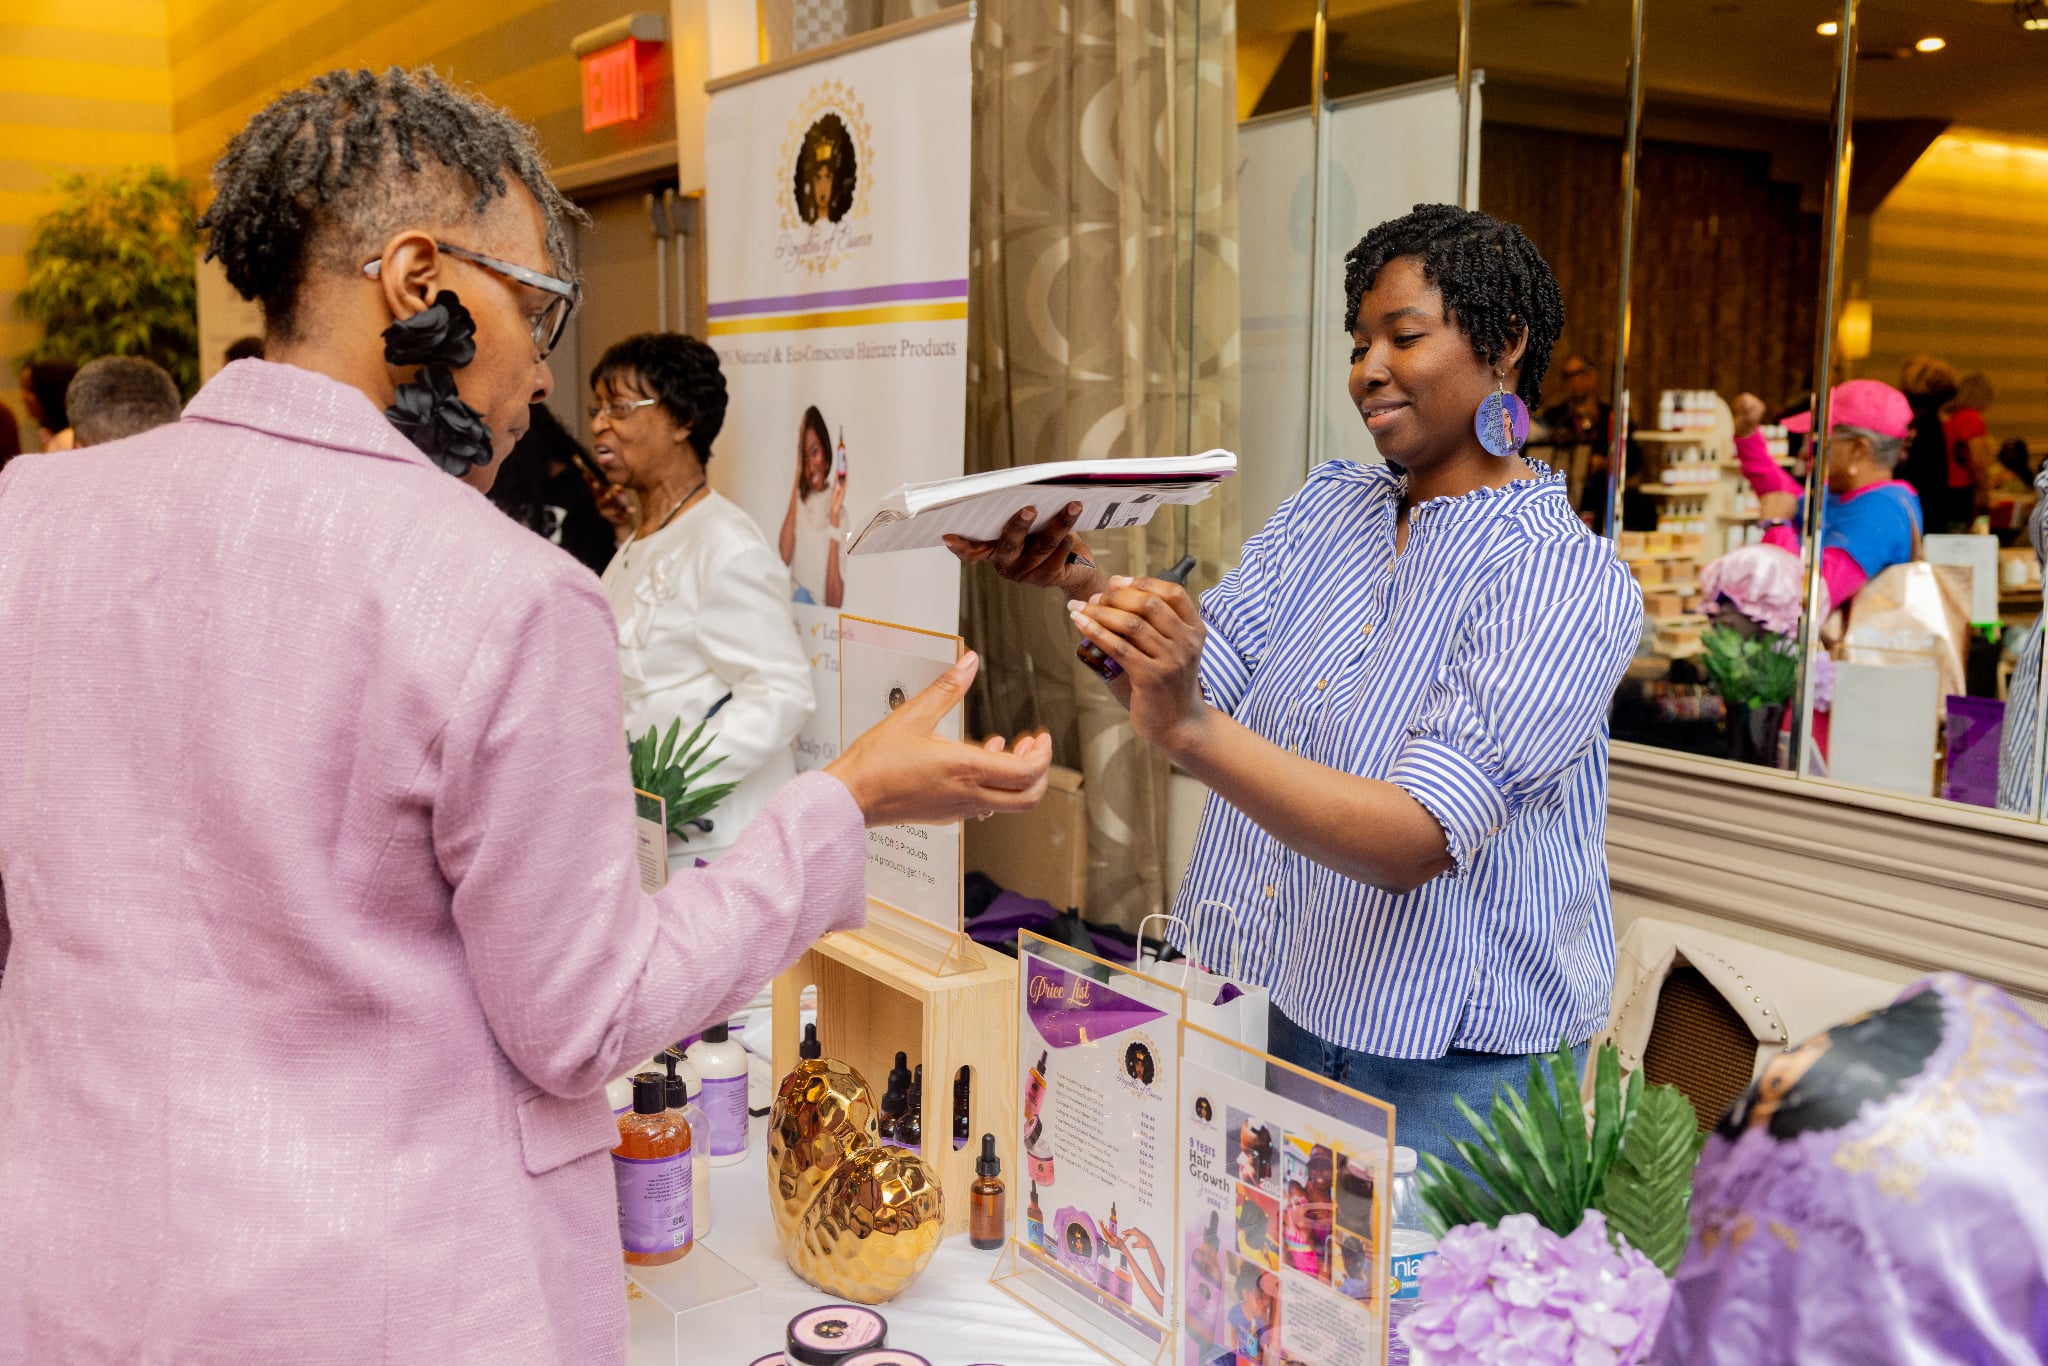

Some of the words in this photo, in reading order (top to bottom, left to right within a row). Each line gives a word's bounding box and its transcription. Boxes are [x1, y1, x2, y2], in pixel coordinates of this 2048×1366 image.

[773, 346, 782, 364] &
[901, 338, 957, 358] Products
[901, 842, 928, 861] Products
[879, 856, 906, 874] products
[907, 866, 917, 878] get
[1029, 975, 1065, 1004] Price
[1067, 976, 1091, 1007] List
[1189, 1137, 1195, 1148] 9
[1196, 1139, 1217, 1158] Years
[1189, 1149, 1213, 1169] Hair
[1189, 1163, 1230, 1194] Growth
